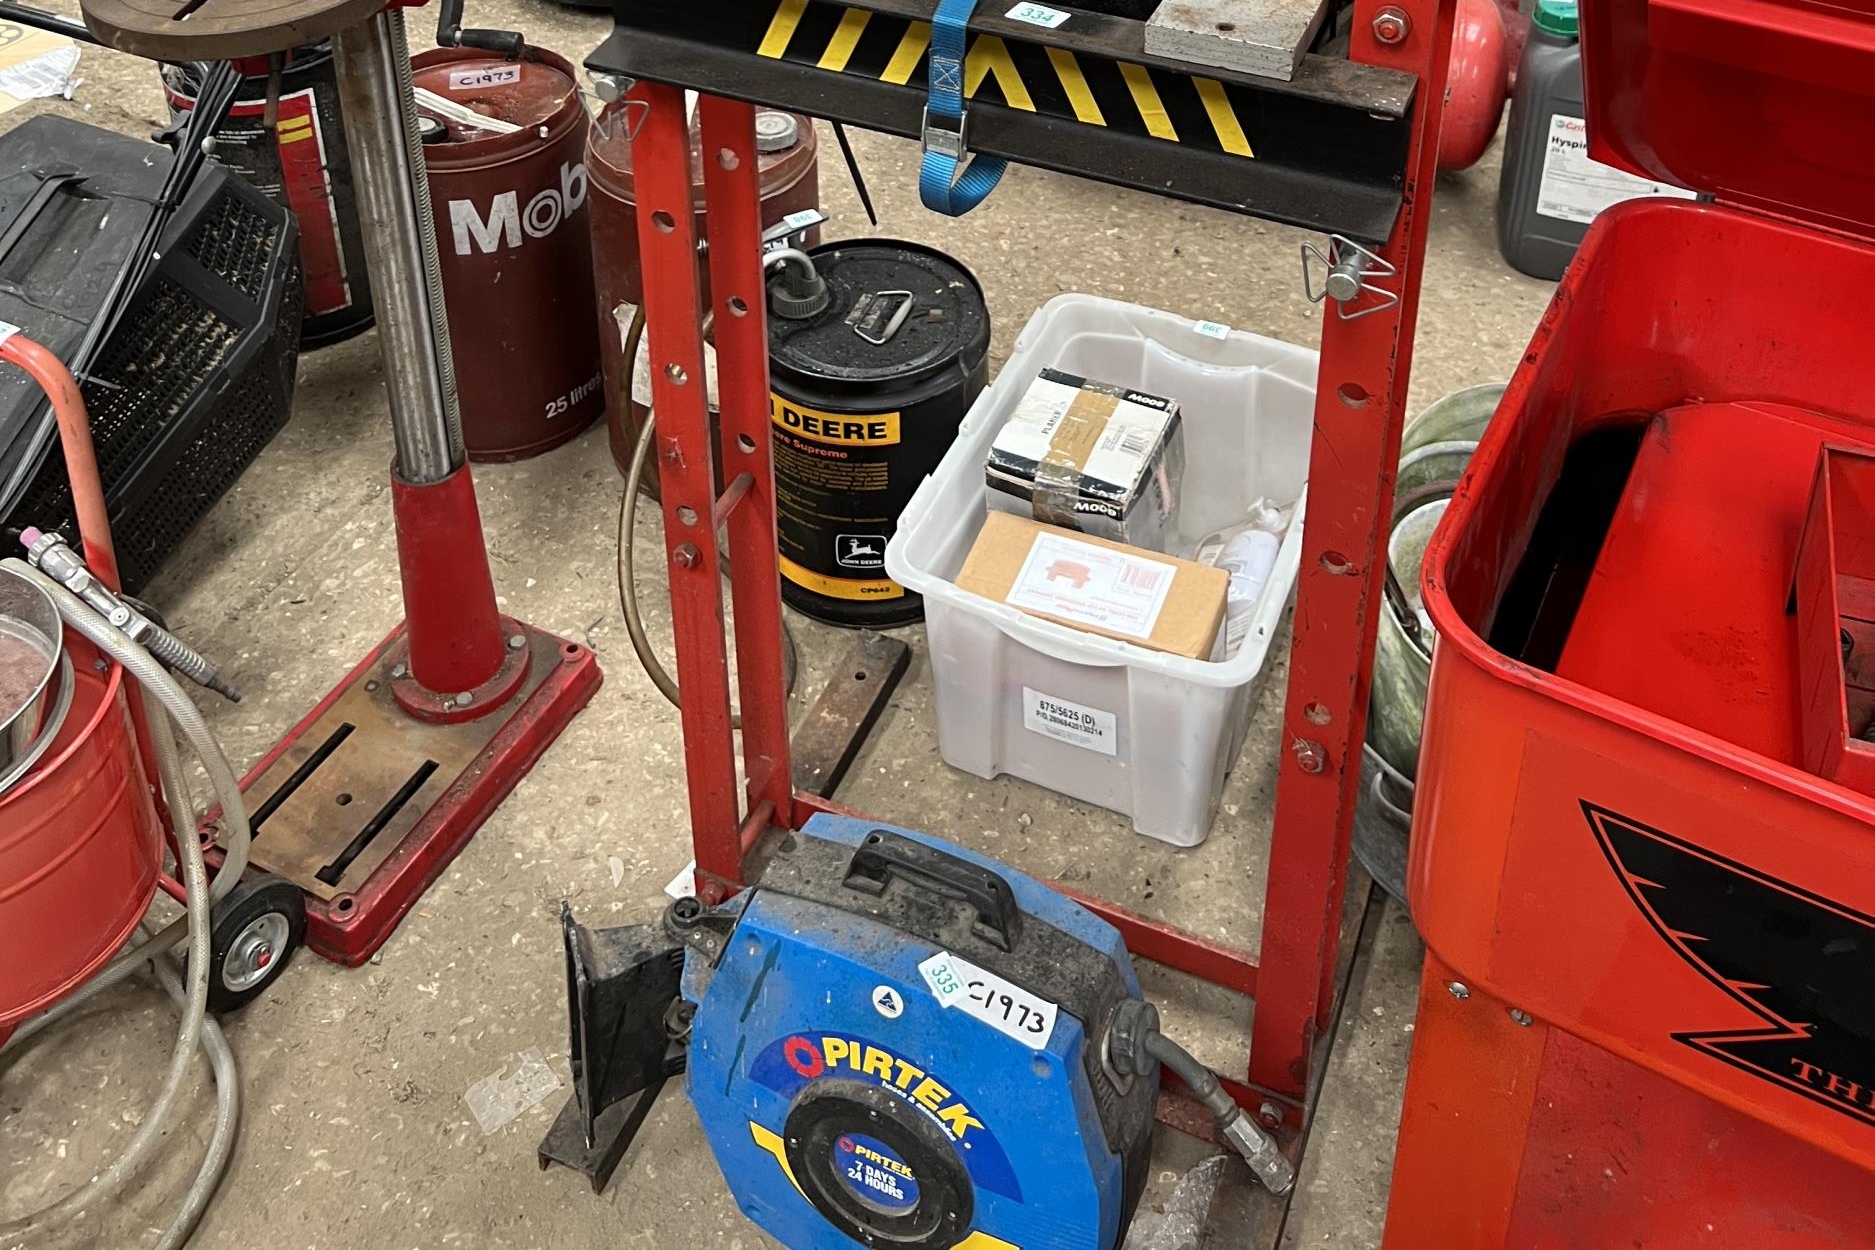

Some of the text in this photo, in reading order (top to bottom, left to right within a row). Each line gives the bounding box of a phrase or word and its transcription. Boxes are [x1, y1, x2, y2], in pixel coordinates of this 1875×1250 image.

[1021, 7, 1055, 21] 334
[460, 72, 514, 86] C1973
[448, 161, 587, 255] Mob
[545, 395, 568, 419] 25
[783, 406, 887, 441] DEERE
[793, 439, 848, 458] Supreme
[1040, 700, 1095, 727] 875/5625 (D)
[932, 964, 959, 994] 335
[968, 981, 1044, 1033] C1973
[822, 1037, 985, 1139] PIRTEK
[855, 1145, 912, 1177] PIRTEK
[855, 1160, 863, 1171] 7
[866, 1165, 896, 1187] DAYS
[848, 1168, 862, 1181] 24
[865, 1175, 903, 1200] HOURS
